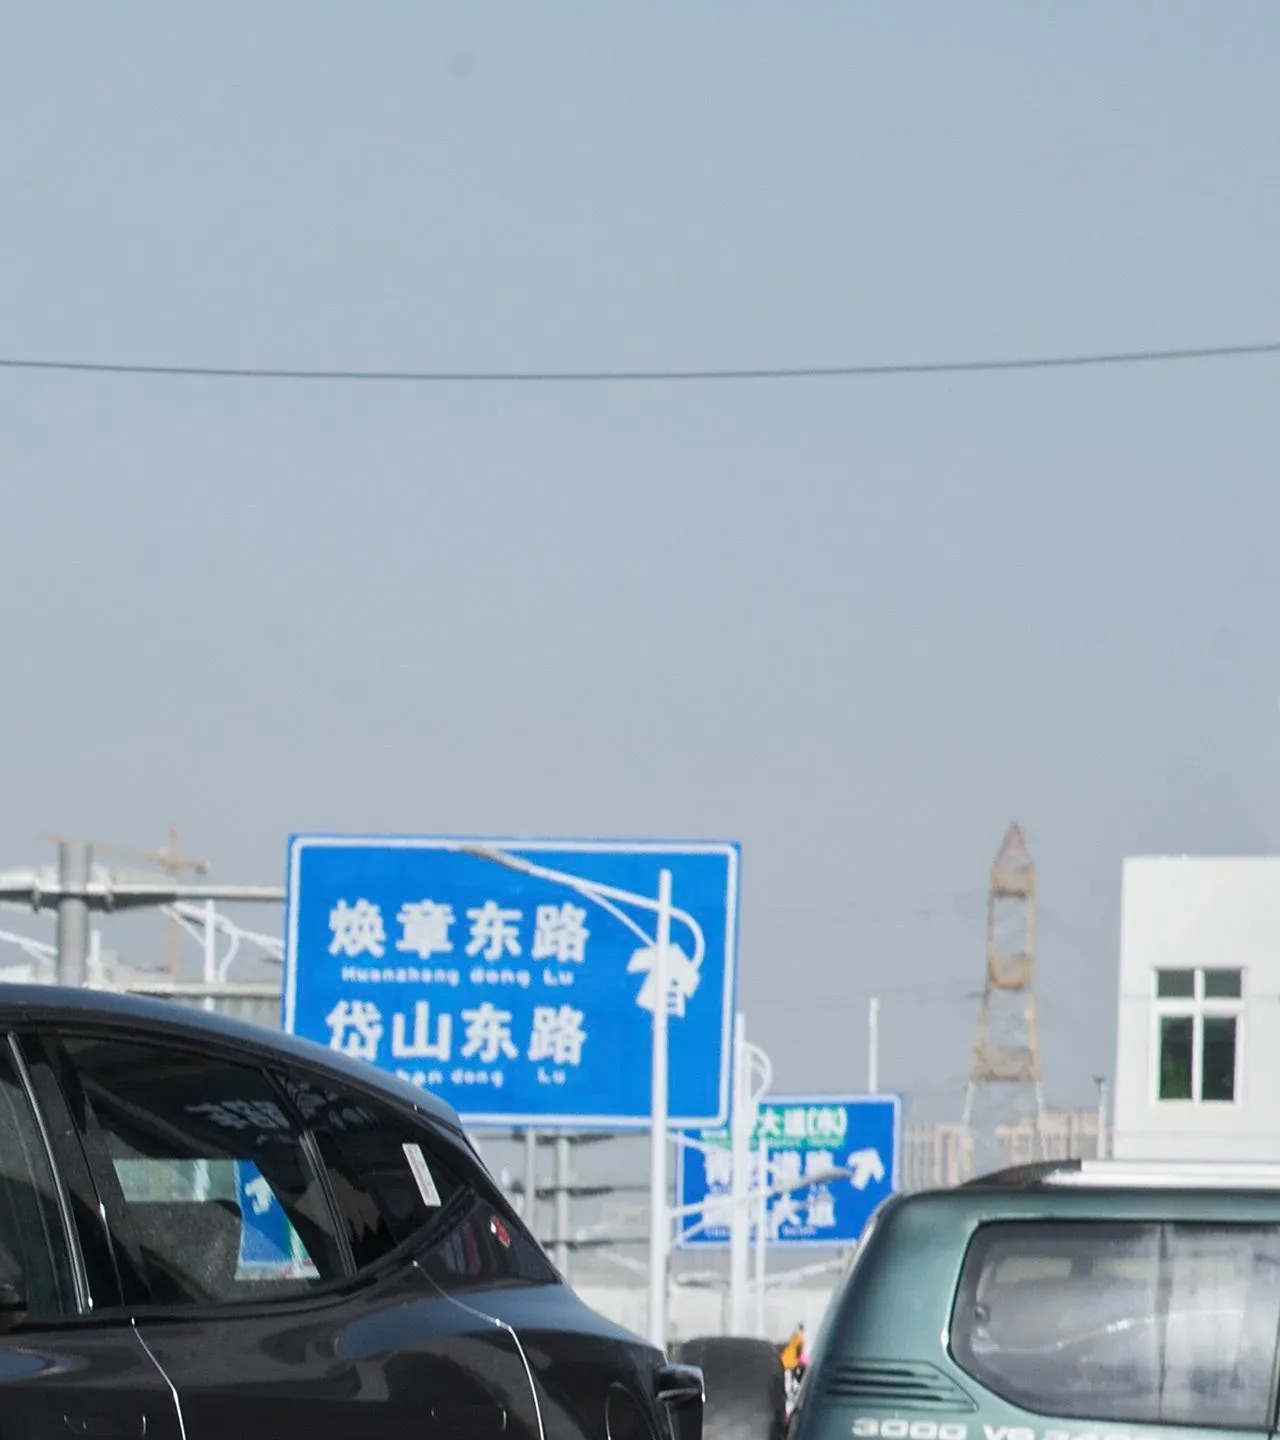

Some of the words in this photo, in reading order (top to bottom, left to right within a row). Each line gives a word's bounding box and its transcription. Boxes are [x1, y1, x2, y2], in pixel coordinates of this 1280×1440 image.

[327, 898, 590, 963] 焕章东路
[542, 966, 574, 986] Lu
[325, 999, 589, 1067] 岱山东路
